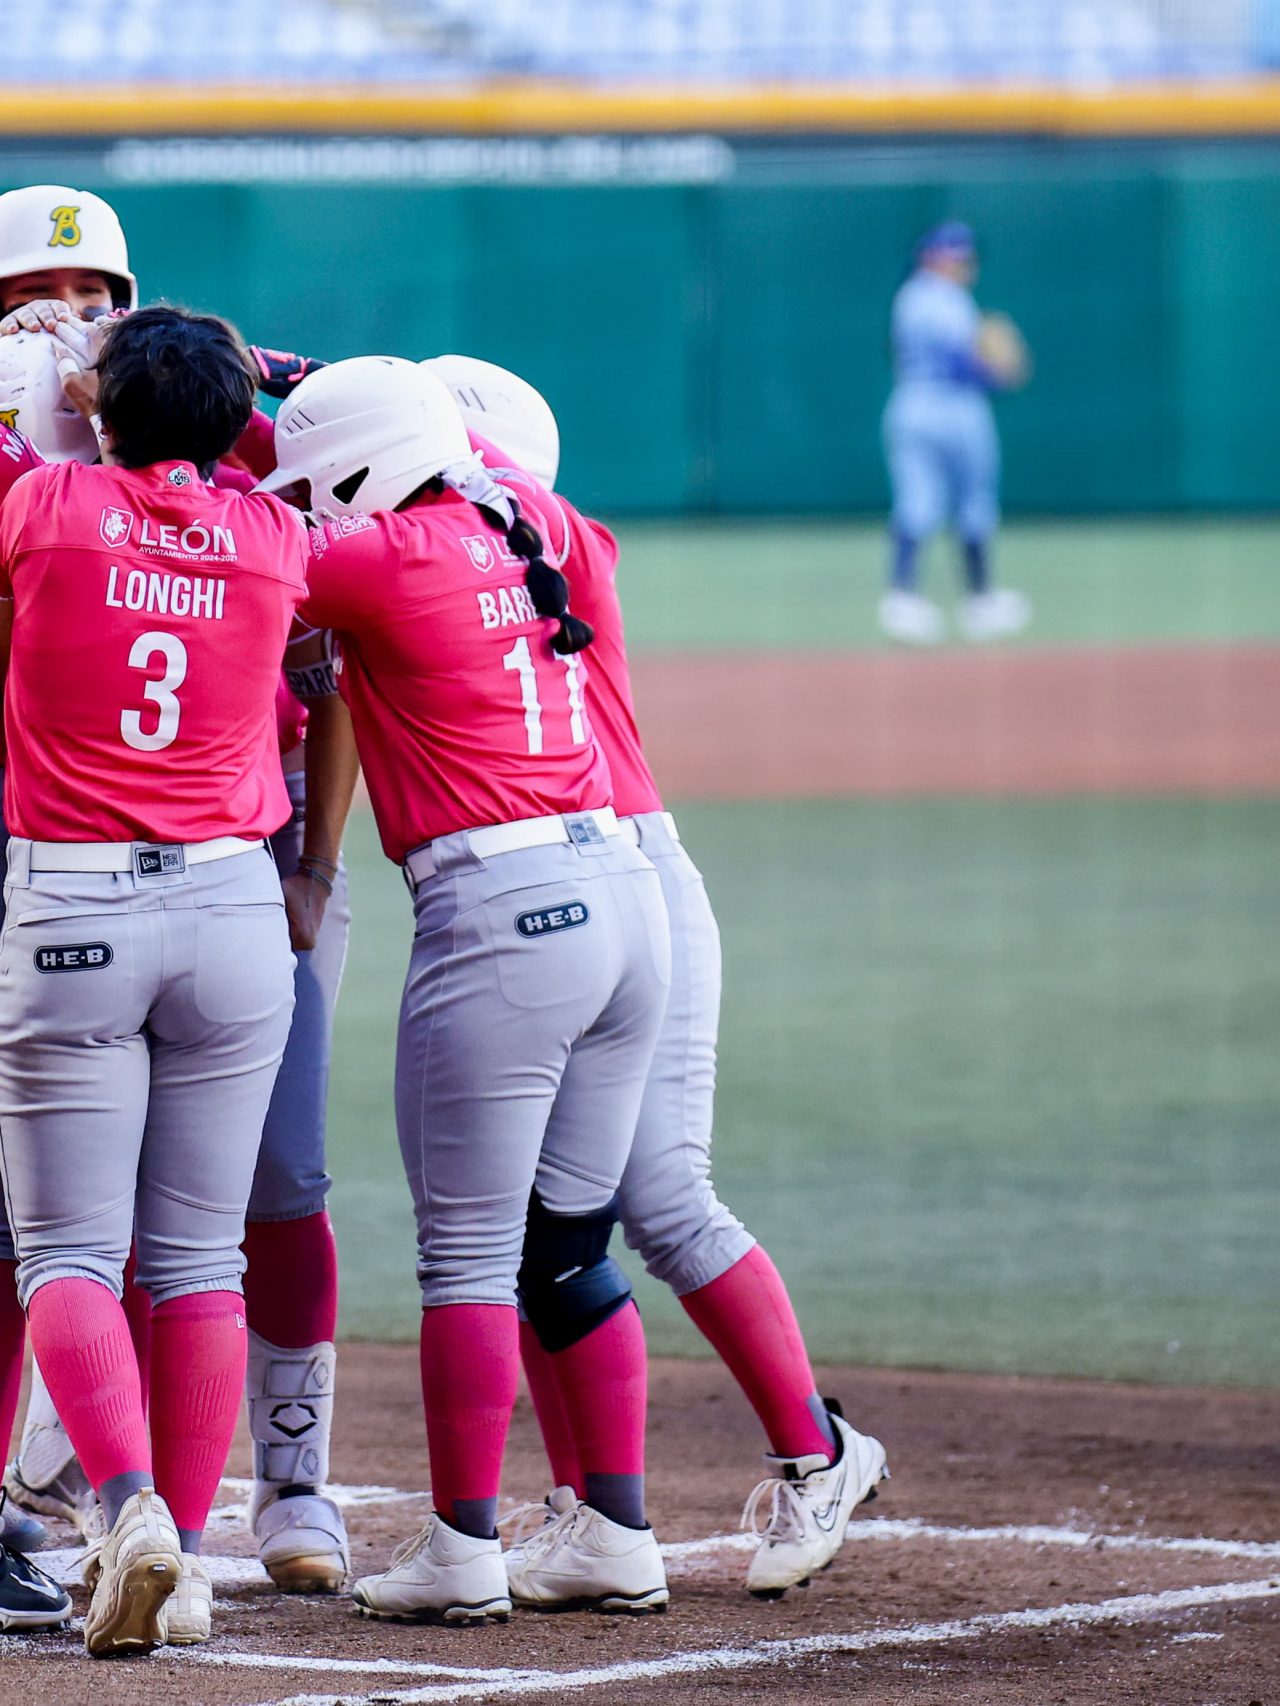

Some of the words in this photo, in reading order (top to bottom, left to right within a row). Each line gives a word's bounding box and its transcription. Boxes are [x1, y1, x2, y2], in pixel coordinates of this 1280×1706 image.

[49, 205, 81, 247] B
[140, 518, 237, 555] LEÓN
[105, 565, 227, 620] LONGHI
[120, 630, 188, 752] 3
[502, 636, 586, 755] 11
